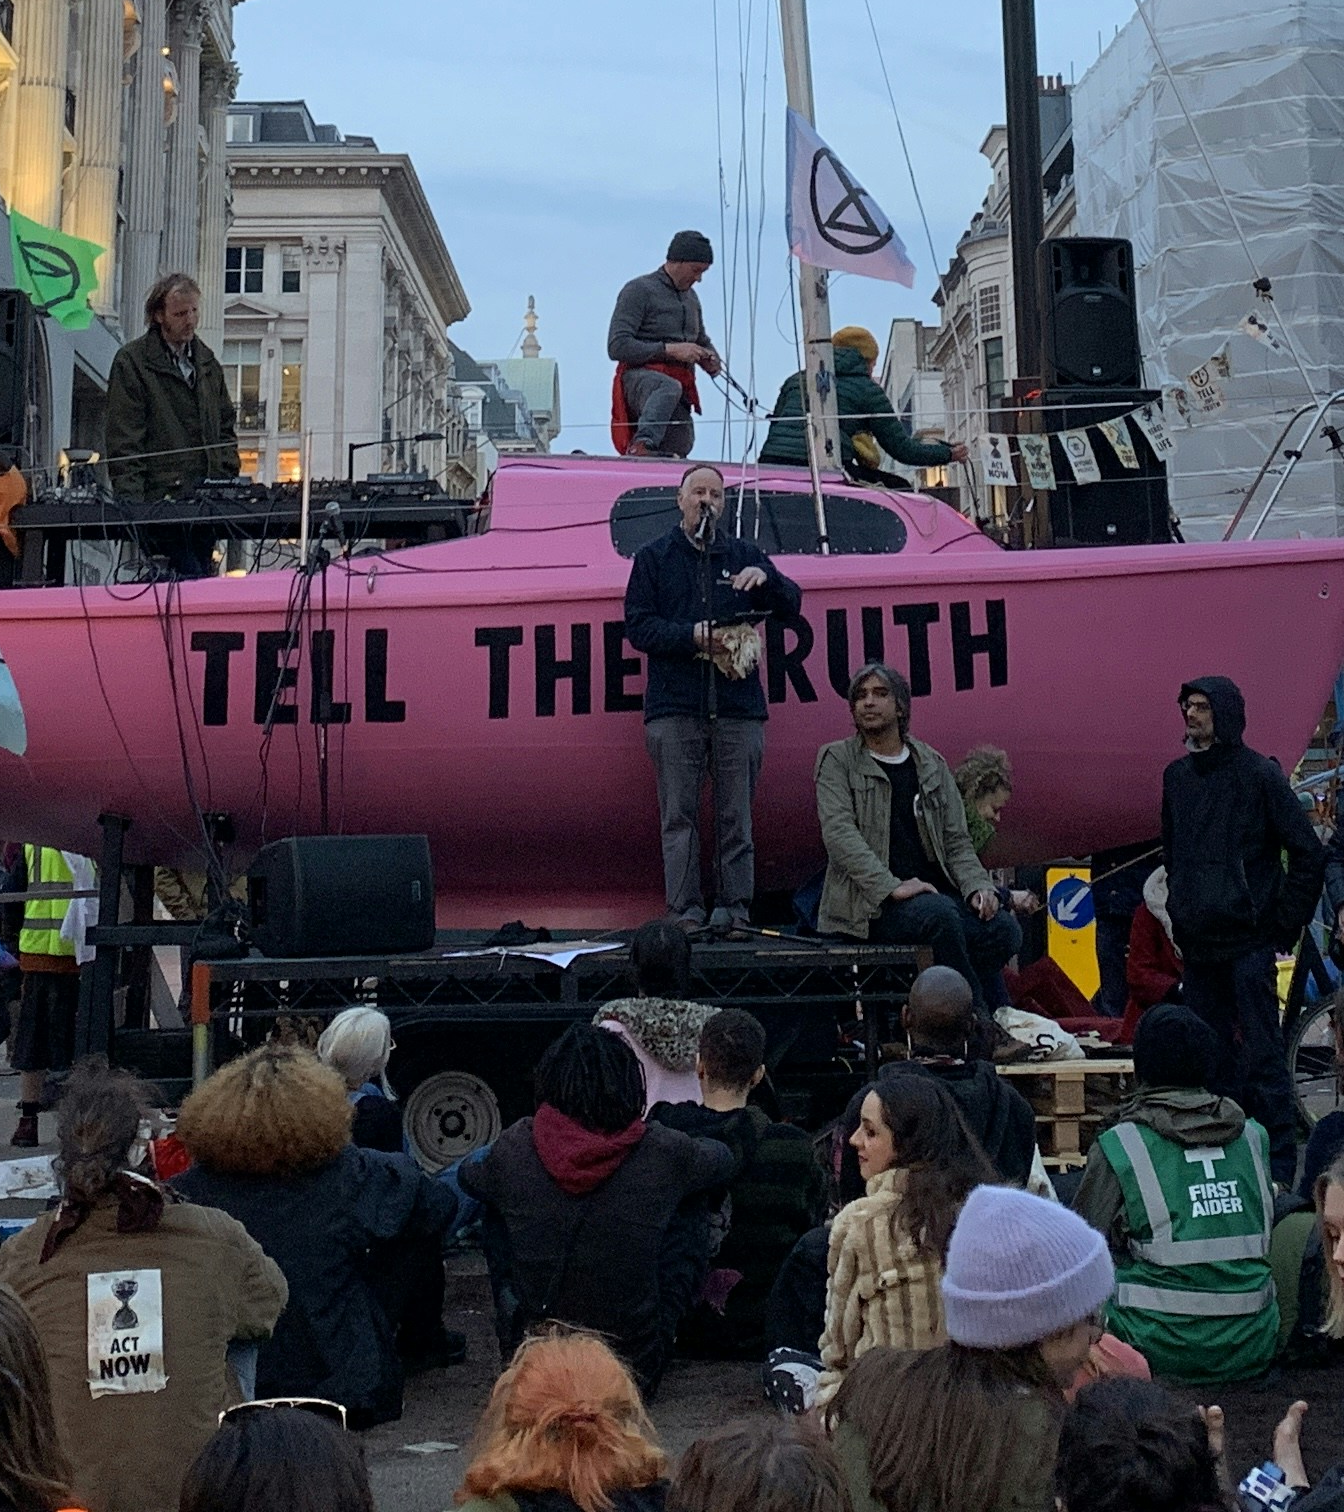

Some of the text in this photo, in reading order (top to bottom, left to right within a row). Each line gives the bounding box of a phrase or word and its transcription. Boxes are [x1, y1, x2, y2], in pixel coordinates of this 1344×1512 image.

[1156, 437, 1173, 452] LIFE
[988, 469, 1009, 479] NOW
[991, 461, 1003, 470] ACT
[190, 598, 1009, 726] TELL THE RUTH
[1189, 1180, 1238, 1202] FIRST
[1192, 1197, 1244, 1219] AIDER
[110, 1336, 140, 1355] ACT
[99, 1353, 151, 1380] NOW
